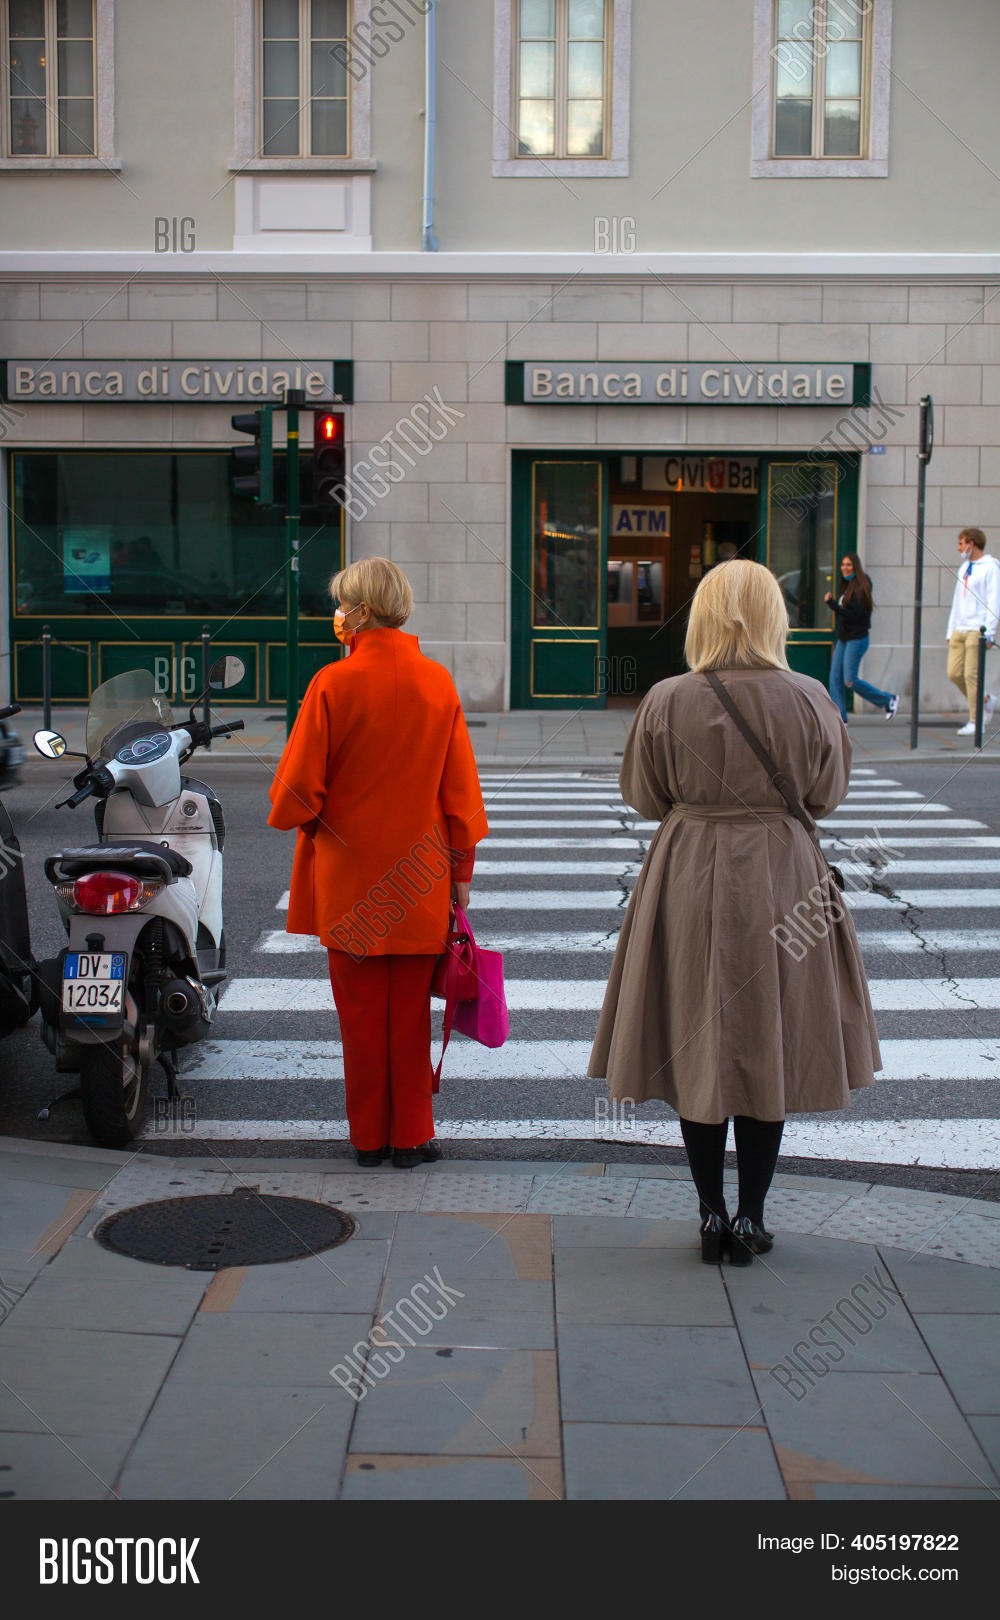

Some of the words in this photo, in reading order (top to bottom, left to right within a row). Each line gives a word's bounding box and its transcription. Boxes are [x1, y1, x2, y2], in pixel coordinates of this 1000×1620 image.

[14, 367, 125, 396] Banca
[137, 366, 169, 395] di
[180, 366, 326, 396] Cividale
[531, 368, 642, 397] Banca
[655, 368, 688, 397] di
[700, 368, 846, 398] Cividale
[665, 458, 704, 487] Civi
[616, 510, 666, 531] ATM
[79, 955, 101, 977] DV
[67, 984, 121, 1007] 12034
